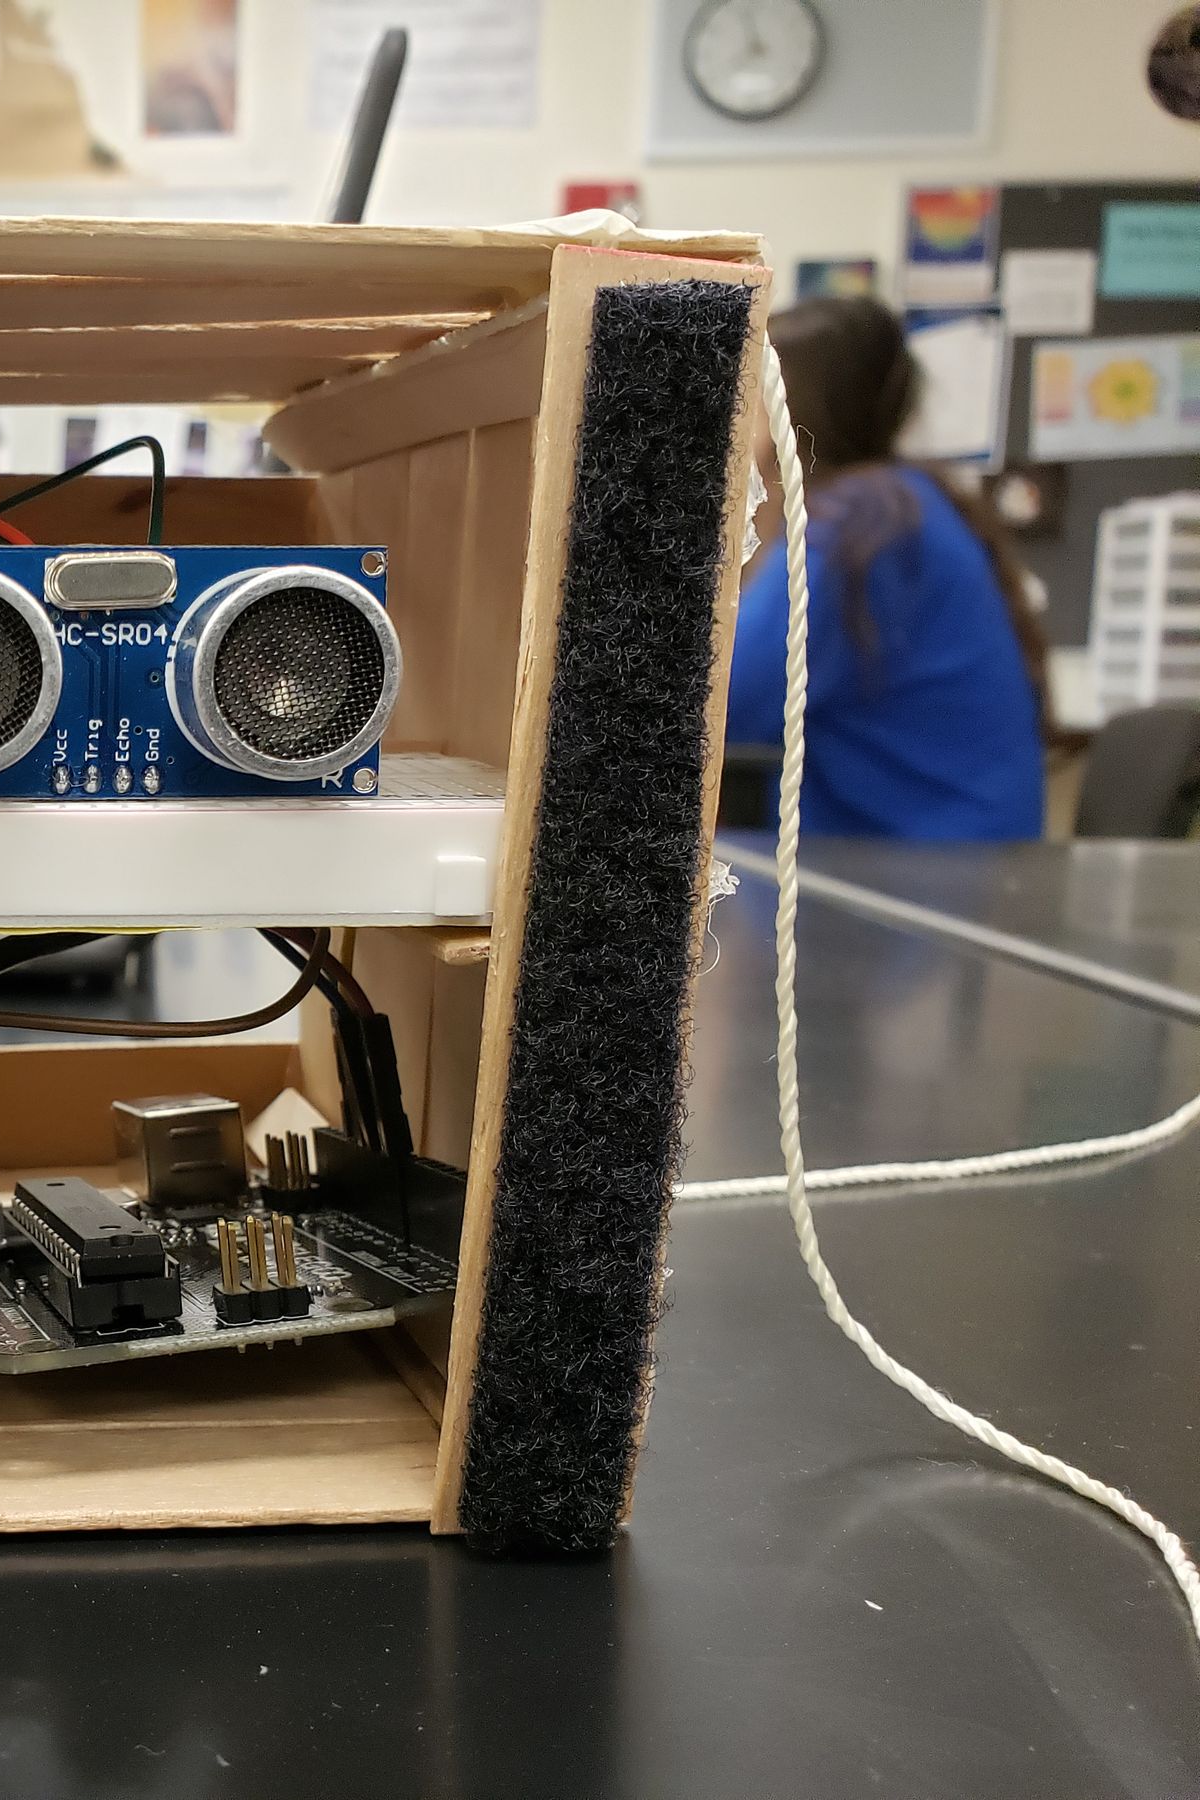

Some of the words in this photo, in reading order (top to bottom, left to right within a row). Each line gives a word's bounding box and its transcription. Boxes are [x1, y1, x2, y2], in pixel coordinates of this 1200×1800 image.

[52, 729, 68, 766] Vcc
[85, 719, 103, 761] Trig
[115, 718, 130, 762] Echo
[145, 728, 160, 762] Gnd
